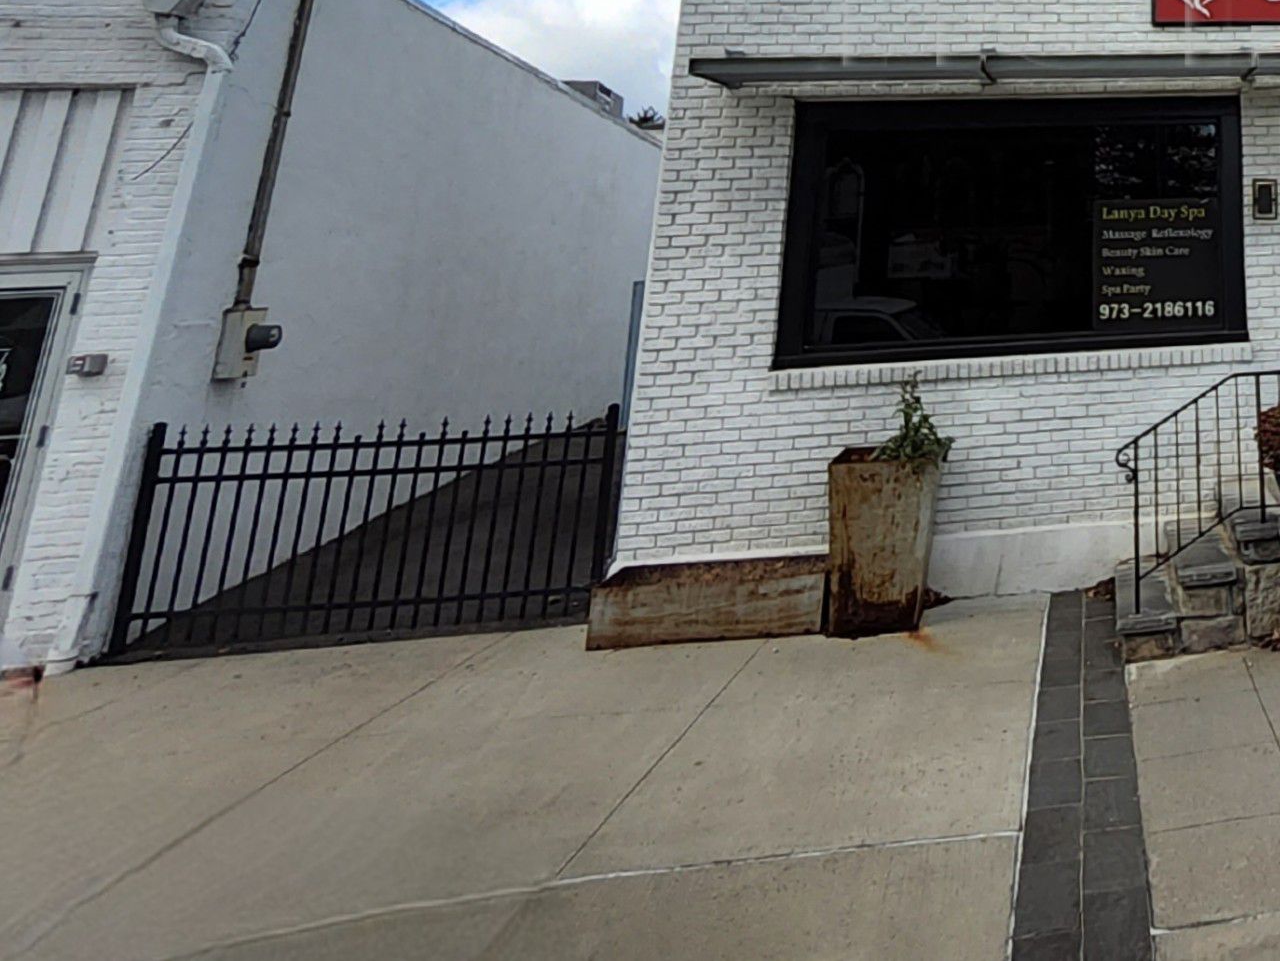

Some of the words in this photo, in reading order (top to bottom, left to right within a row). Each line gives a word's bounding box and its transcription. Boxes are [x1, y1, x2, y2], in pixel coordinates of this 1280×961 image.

[1102, 207, 1145, 222] Lanya
[1149, 205, 1178, 221] Day
[1180, 204, 1206, 221] Spa
[1101, 247, 1139, 259] Beauty
[1140, 246, 1164, 257] Skin
[1165, 245, 1190, 256] Care
[1102, 265, 1146, 277] Waxing
[1101, 284, 1121, 297] Spa
[1122, 283, 1152, 296] Party
[1099, 300, 1215, 320] 973-2186116
